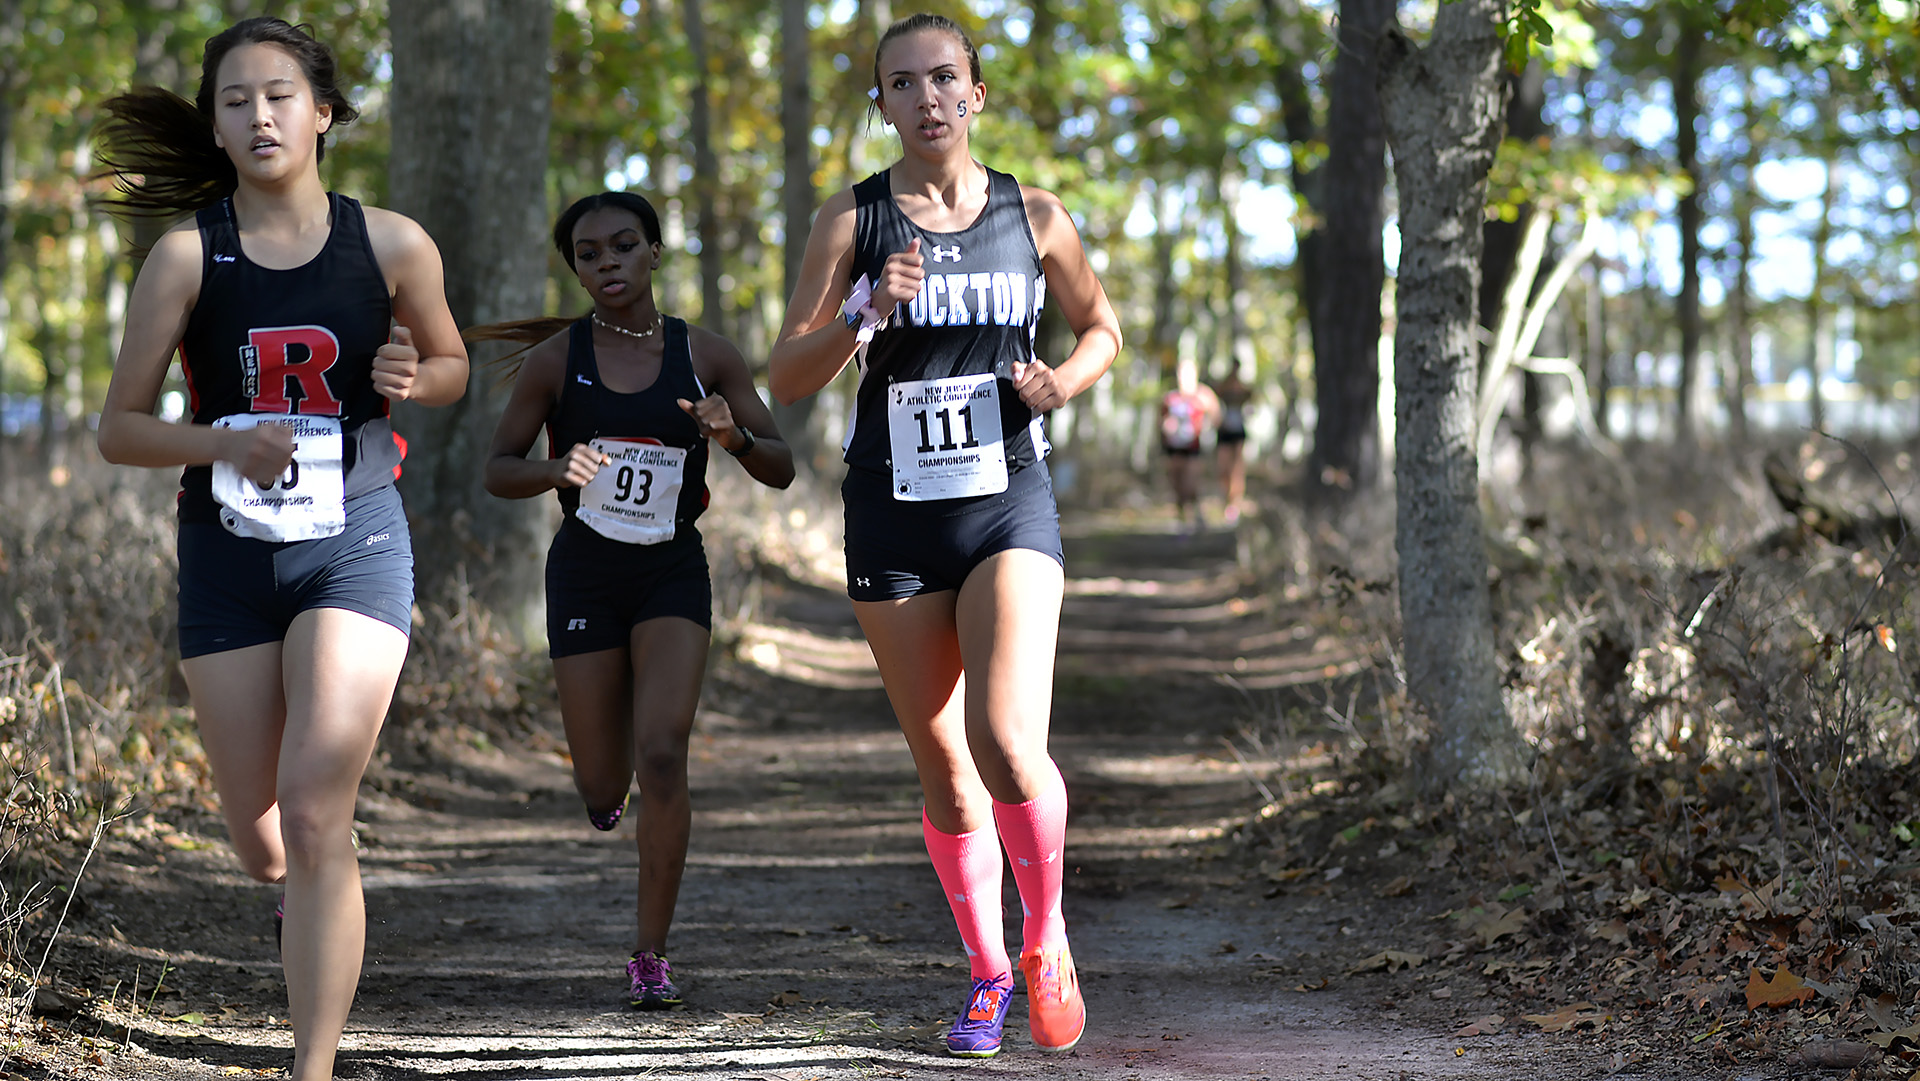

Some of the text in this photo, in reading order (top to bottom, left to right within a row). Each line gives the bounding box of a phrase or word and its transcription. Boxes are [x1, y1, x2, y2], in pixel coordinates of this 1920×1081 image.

[872, 272, 1027, 329] OCKTON
[249, 324, 342, 415] R
[907, 389, 991, 406] ATHLETIC CONFERENCE
[925, 386, 942, 396] NEW
[294, 427, 333, 437] FERENCE
[914, 405, 979, 454] 111
[625, 447, 665, 459] NEW JERSEY
[640, 454, 678, 467] CONFERENCE
[918, 454, 980, 468] CHAMPIONSHIPS
[614, 466, 653, 505] 93
[243, 496, 314, 507] CHAMPIONSHIPS
[601, 503, 656, 520] CHAMPIONSHIPS
